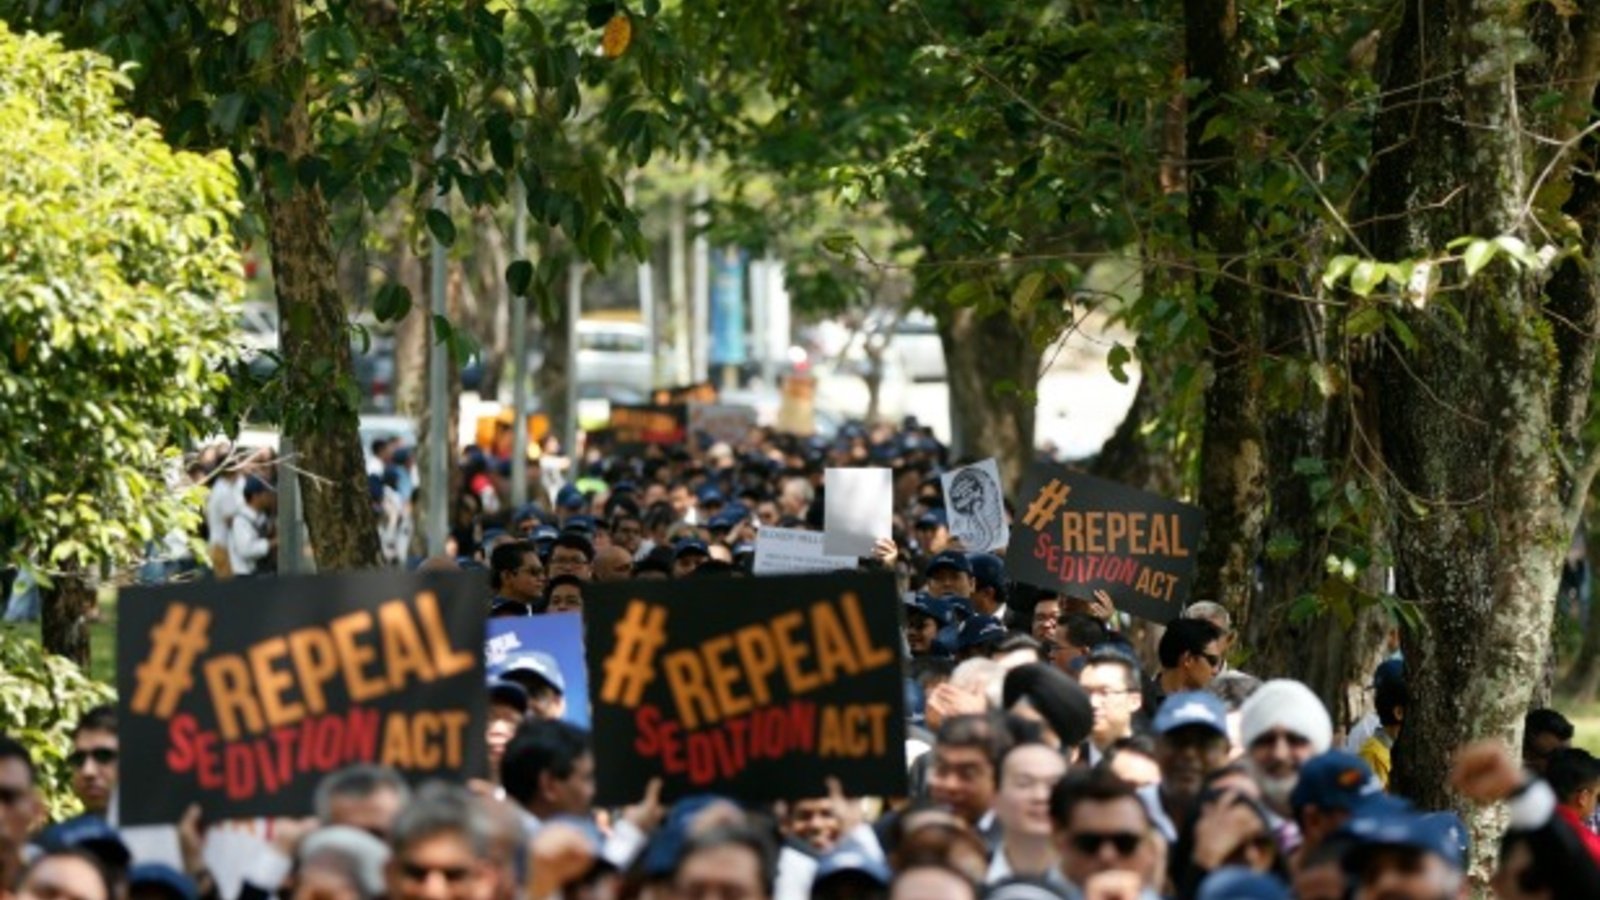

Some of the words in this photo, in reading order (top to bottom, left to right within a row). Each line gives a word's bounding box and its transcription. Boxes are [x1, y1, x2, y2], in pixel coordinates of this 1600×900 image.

[1022, 478, 1189, 557] #REPEAL
[1034, 533, 1139, 585] SEDITION
[1134, 566, 1179, 602] ACT
[131, 590, 475, 742] #REPEAL
[601, 592, 893, 730] #REPEAL
[166, 706, 379, 799] SEDITION
[381, 710, 469, 770] ACT
[635, 702, 816, 784] SEDITION
[819, 703, 891, 758] ACT
